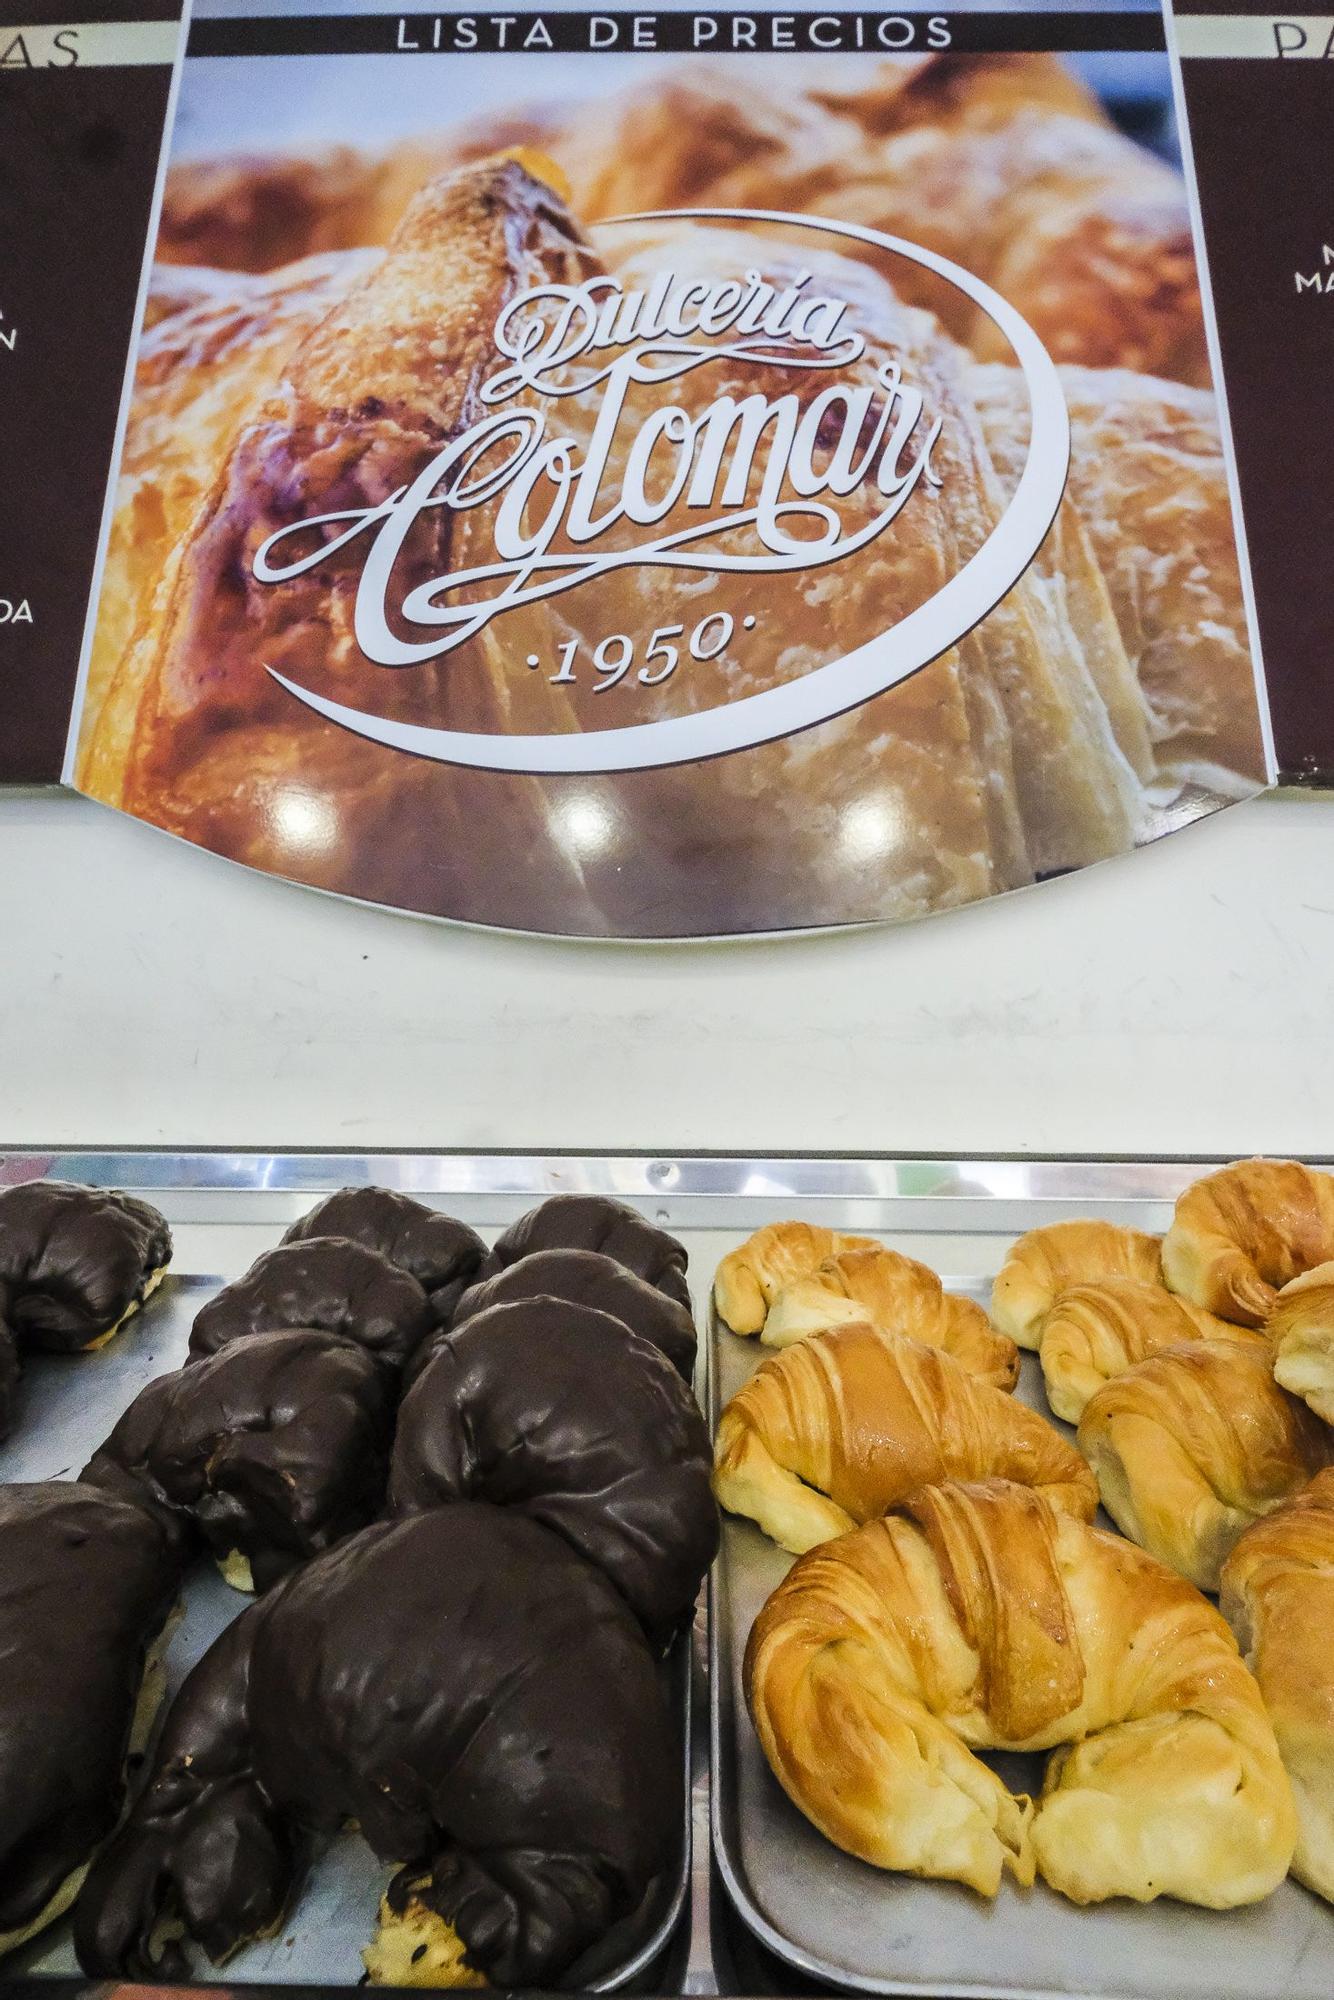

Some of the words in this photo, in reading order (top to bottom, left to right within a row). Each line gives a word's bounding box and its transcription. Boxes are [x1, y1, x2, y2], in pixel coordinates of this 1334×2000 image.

[397, 17, 554, 49] LISTA
[589, 16, 657, 48] DE
[693, 16, 951, 48] PRECIOS
[480, 269, 866, 403] Dulcería
[252, 343, 944, 668] Colomar
